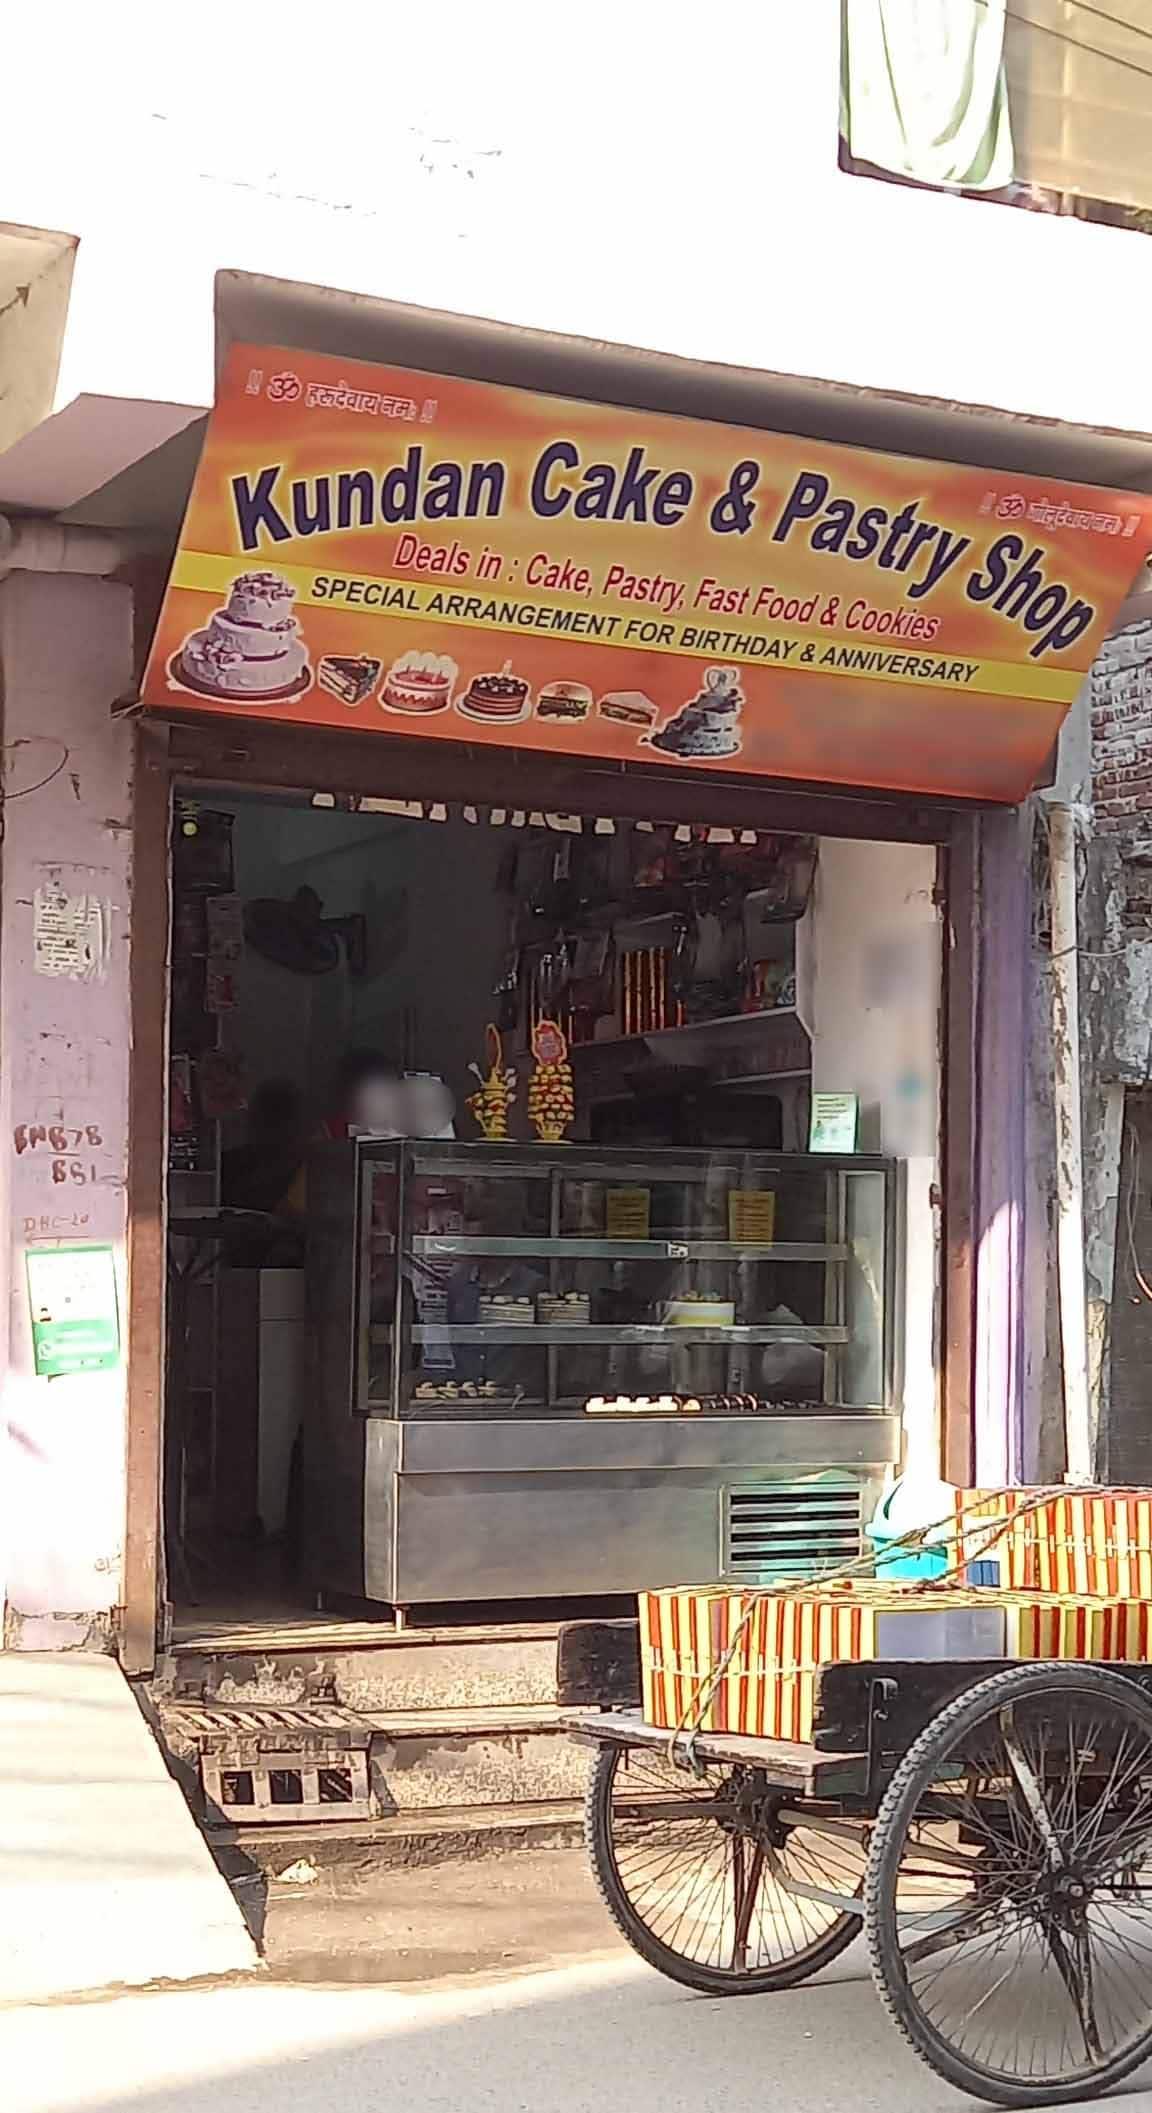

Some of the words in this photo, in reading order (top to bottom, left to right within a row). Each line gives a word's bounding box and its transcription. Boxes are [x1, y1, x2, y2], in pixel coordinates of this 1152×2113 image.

[267, 371, 301, 402] ॐ
[230, 444, 505, 552] Kundan
[530, 439, 695, 528] Cake
[710, 459, 761, 535] &
[771, 470, 971, 600] Pastry
[965, 533, 1096, 658] Shop
[996, 493, 1026, 519] ॐ
[311, 576, 421, 611] SPECIAL
[425, 592, 622, 637] ARRANGEMENT
[623, 619, 676, 645] FOR
[679, 626, 798, 660] BIRTHDAY
[799, 643, 816, 663] &
[819, 645, 980, 684] ANNIVERSARY
[393, 533, 471, 576] Deals
[475, 546, 503, 580] in
[525, 553, 594, 598] Cake,
[602, 564, 685, 614] Pastry,
[693, 577, 749, 615] Fast
[752, 586, 820, 623] Food
[820, 596, 840, 626] &
[844, 599, 940, 639] Cookies
